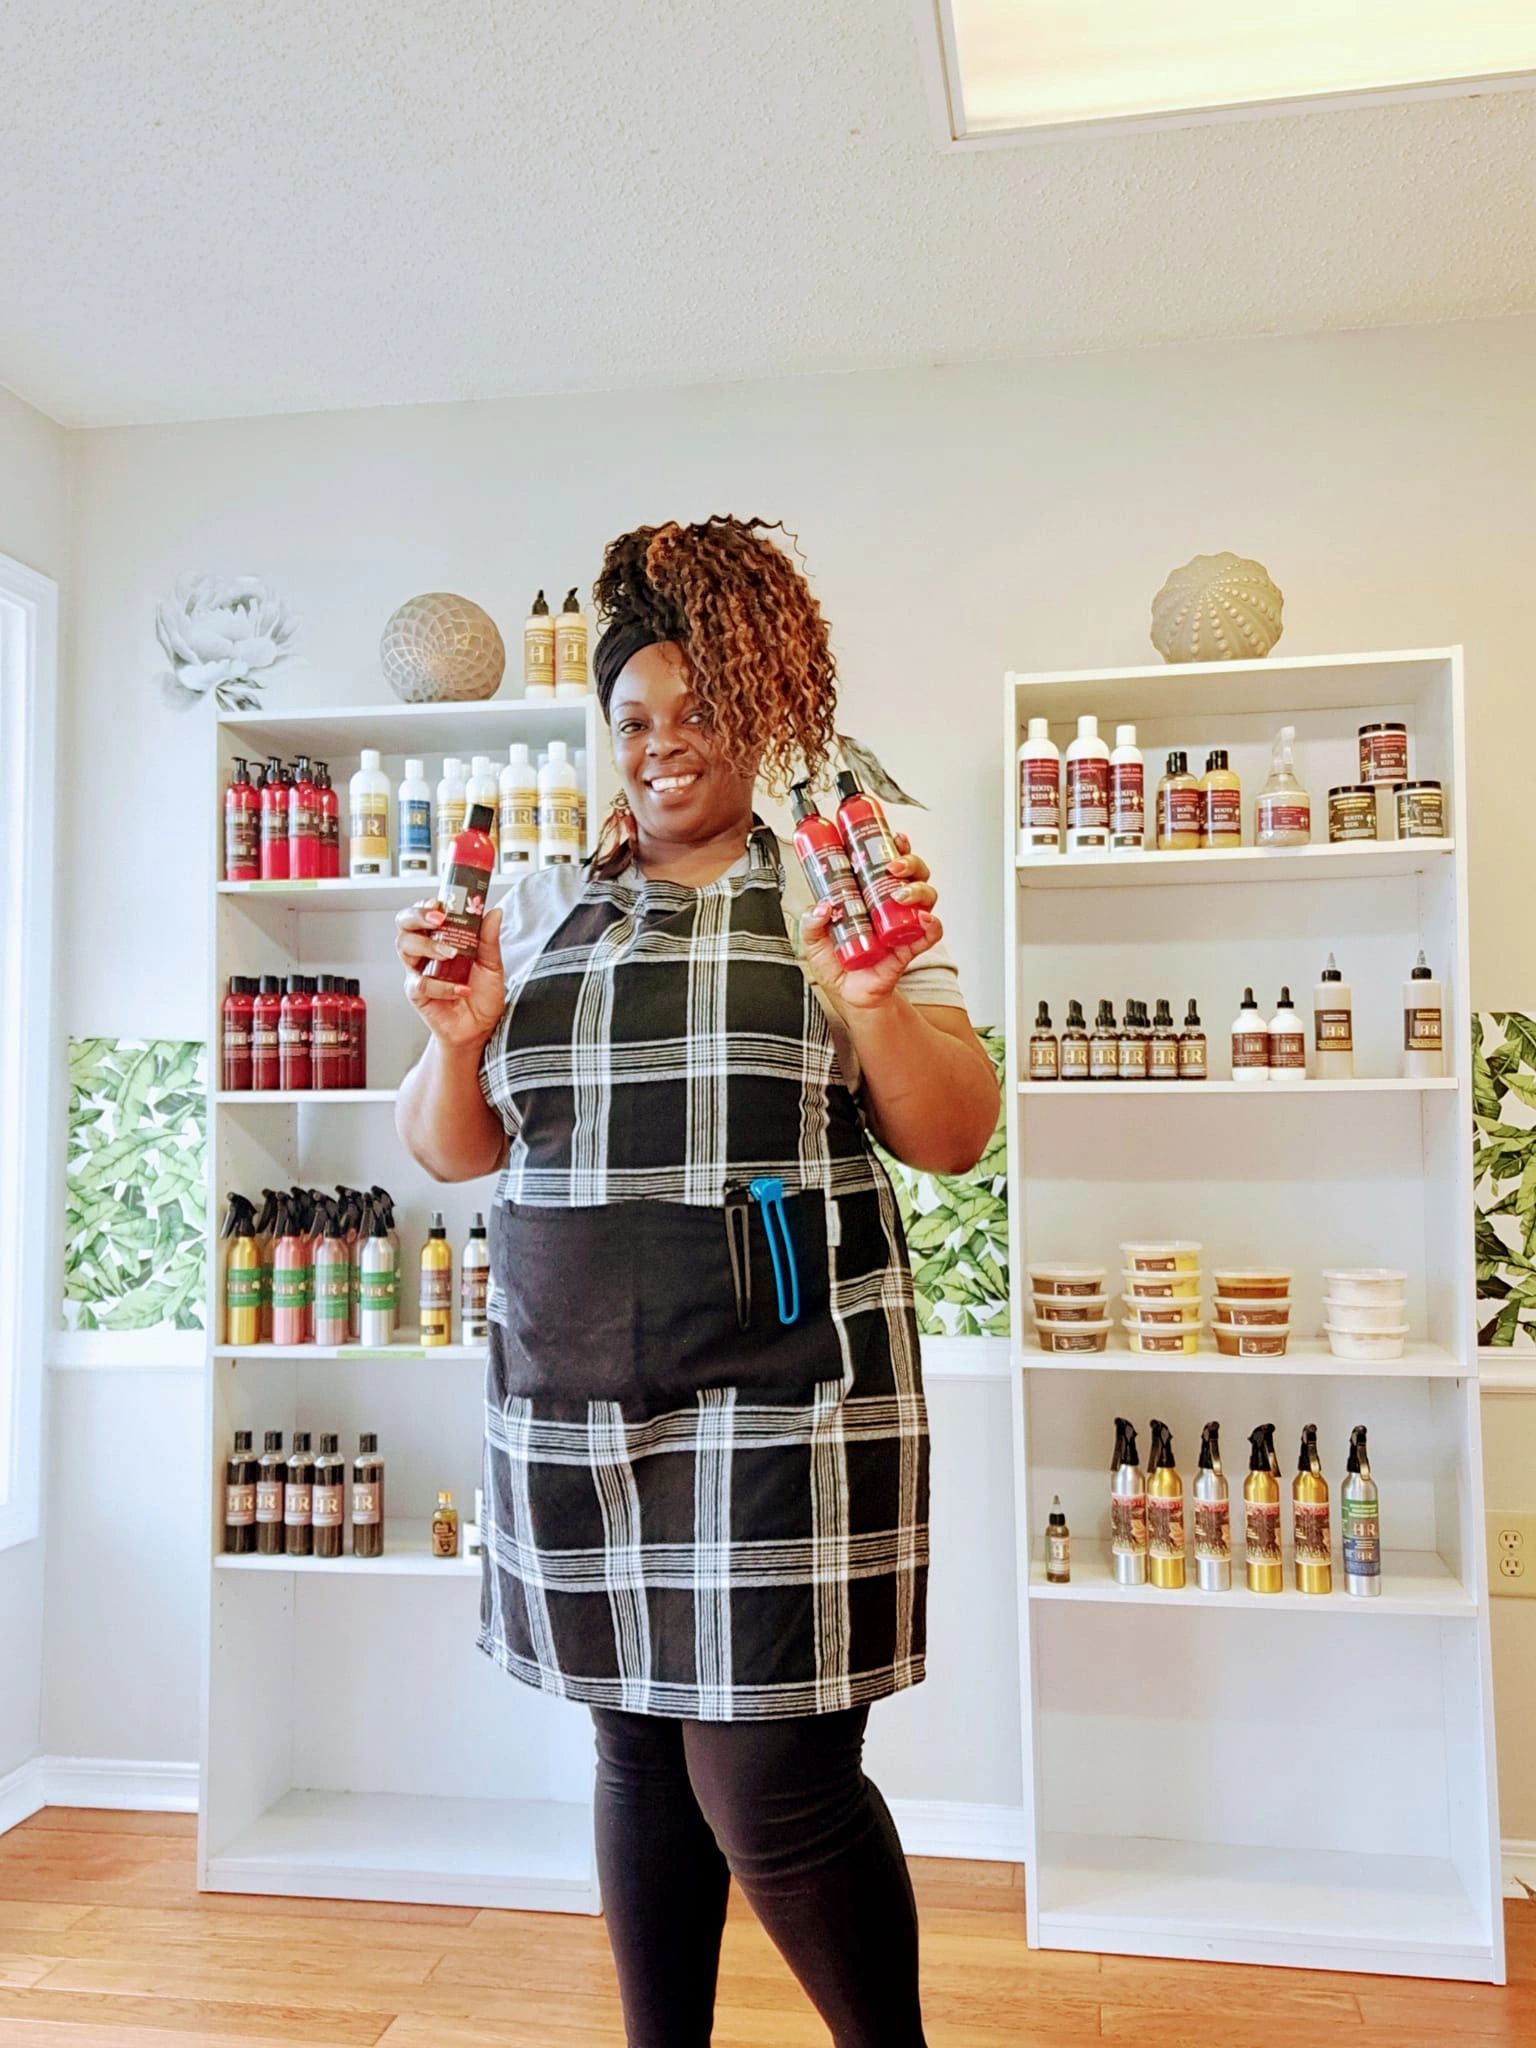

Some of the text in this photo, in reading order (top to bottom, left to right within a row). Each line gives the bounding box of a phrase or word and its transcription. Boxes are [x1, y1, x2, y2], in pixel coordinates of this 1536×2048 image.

[1326, 1026, 1345, 1037] HR
[1420, 1024, 1439, 1035] HR
[1032, 1051, 1056, 1065] HR
[1064, 1050, 1088, 1064] HR
[1094, 1049, 1117, 1064] HR
[1120, 1050, 1144, 1065] HR
[1153, 1050, 1177, 1065] HR
[1180, 1050, 1203, 1063] HR
[230, 1496, 254, 1511] HR
[256, 1495, 276, 1509] HR
[288, 1496, 310, 1511] HR
[316, 1499, 338, 1513] HR
[353, 1495, 374, 1510] HR
[1353, 1523, 1376, 1537] HR
